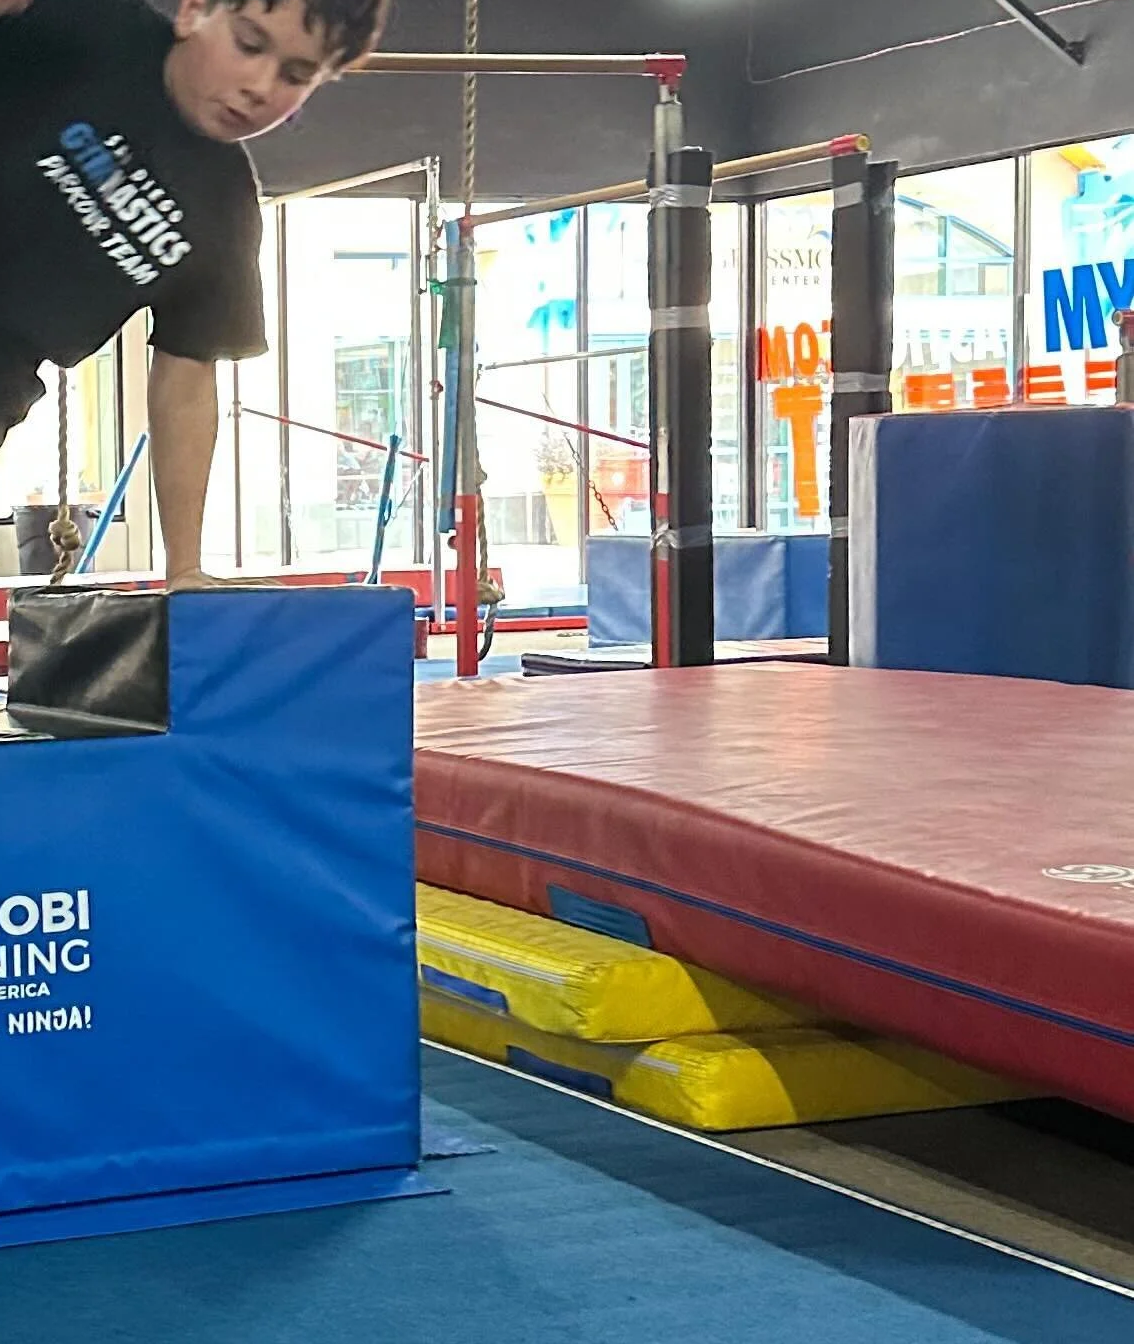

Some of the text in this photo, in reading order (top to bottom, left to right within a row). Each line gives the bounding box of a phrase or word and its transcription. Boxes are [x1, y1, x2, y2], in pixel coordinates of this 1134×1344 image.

[100, 232, 160, 285] TEAM
[771, 275, 821, 286] ENTER
[8, 1005, 92, 1034] NINJA!
